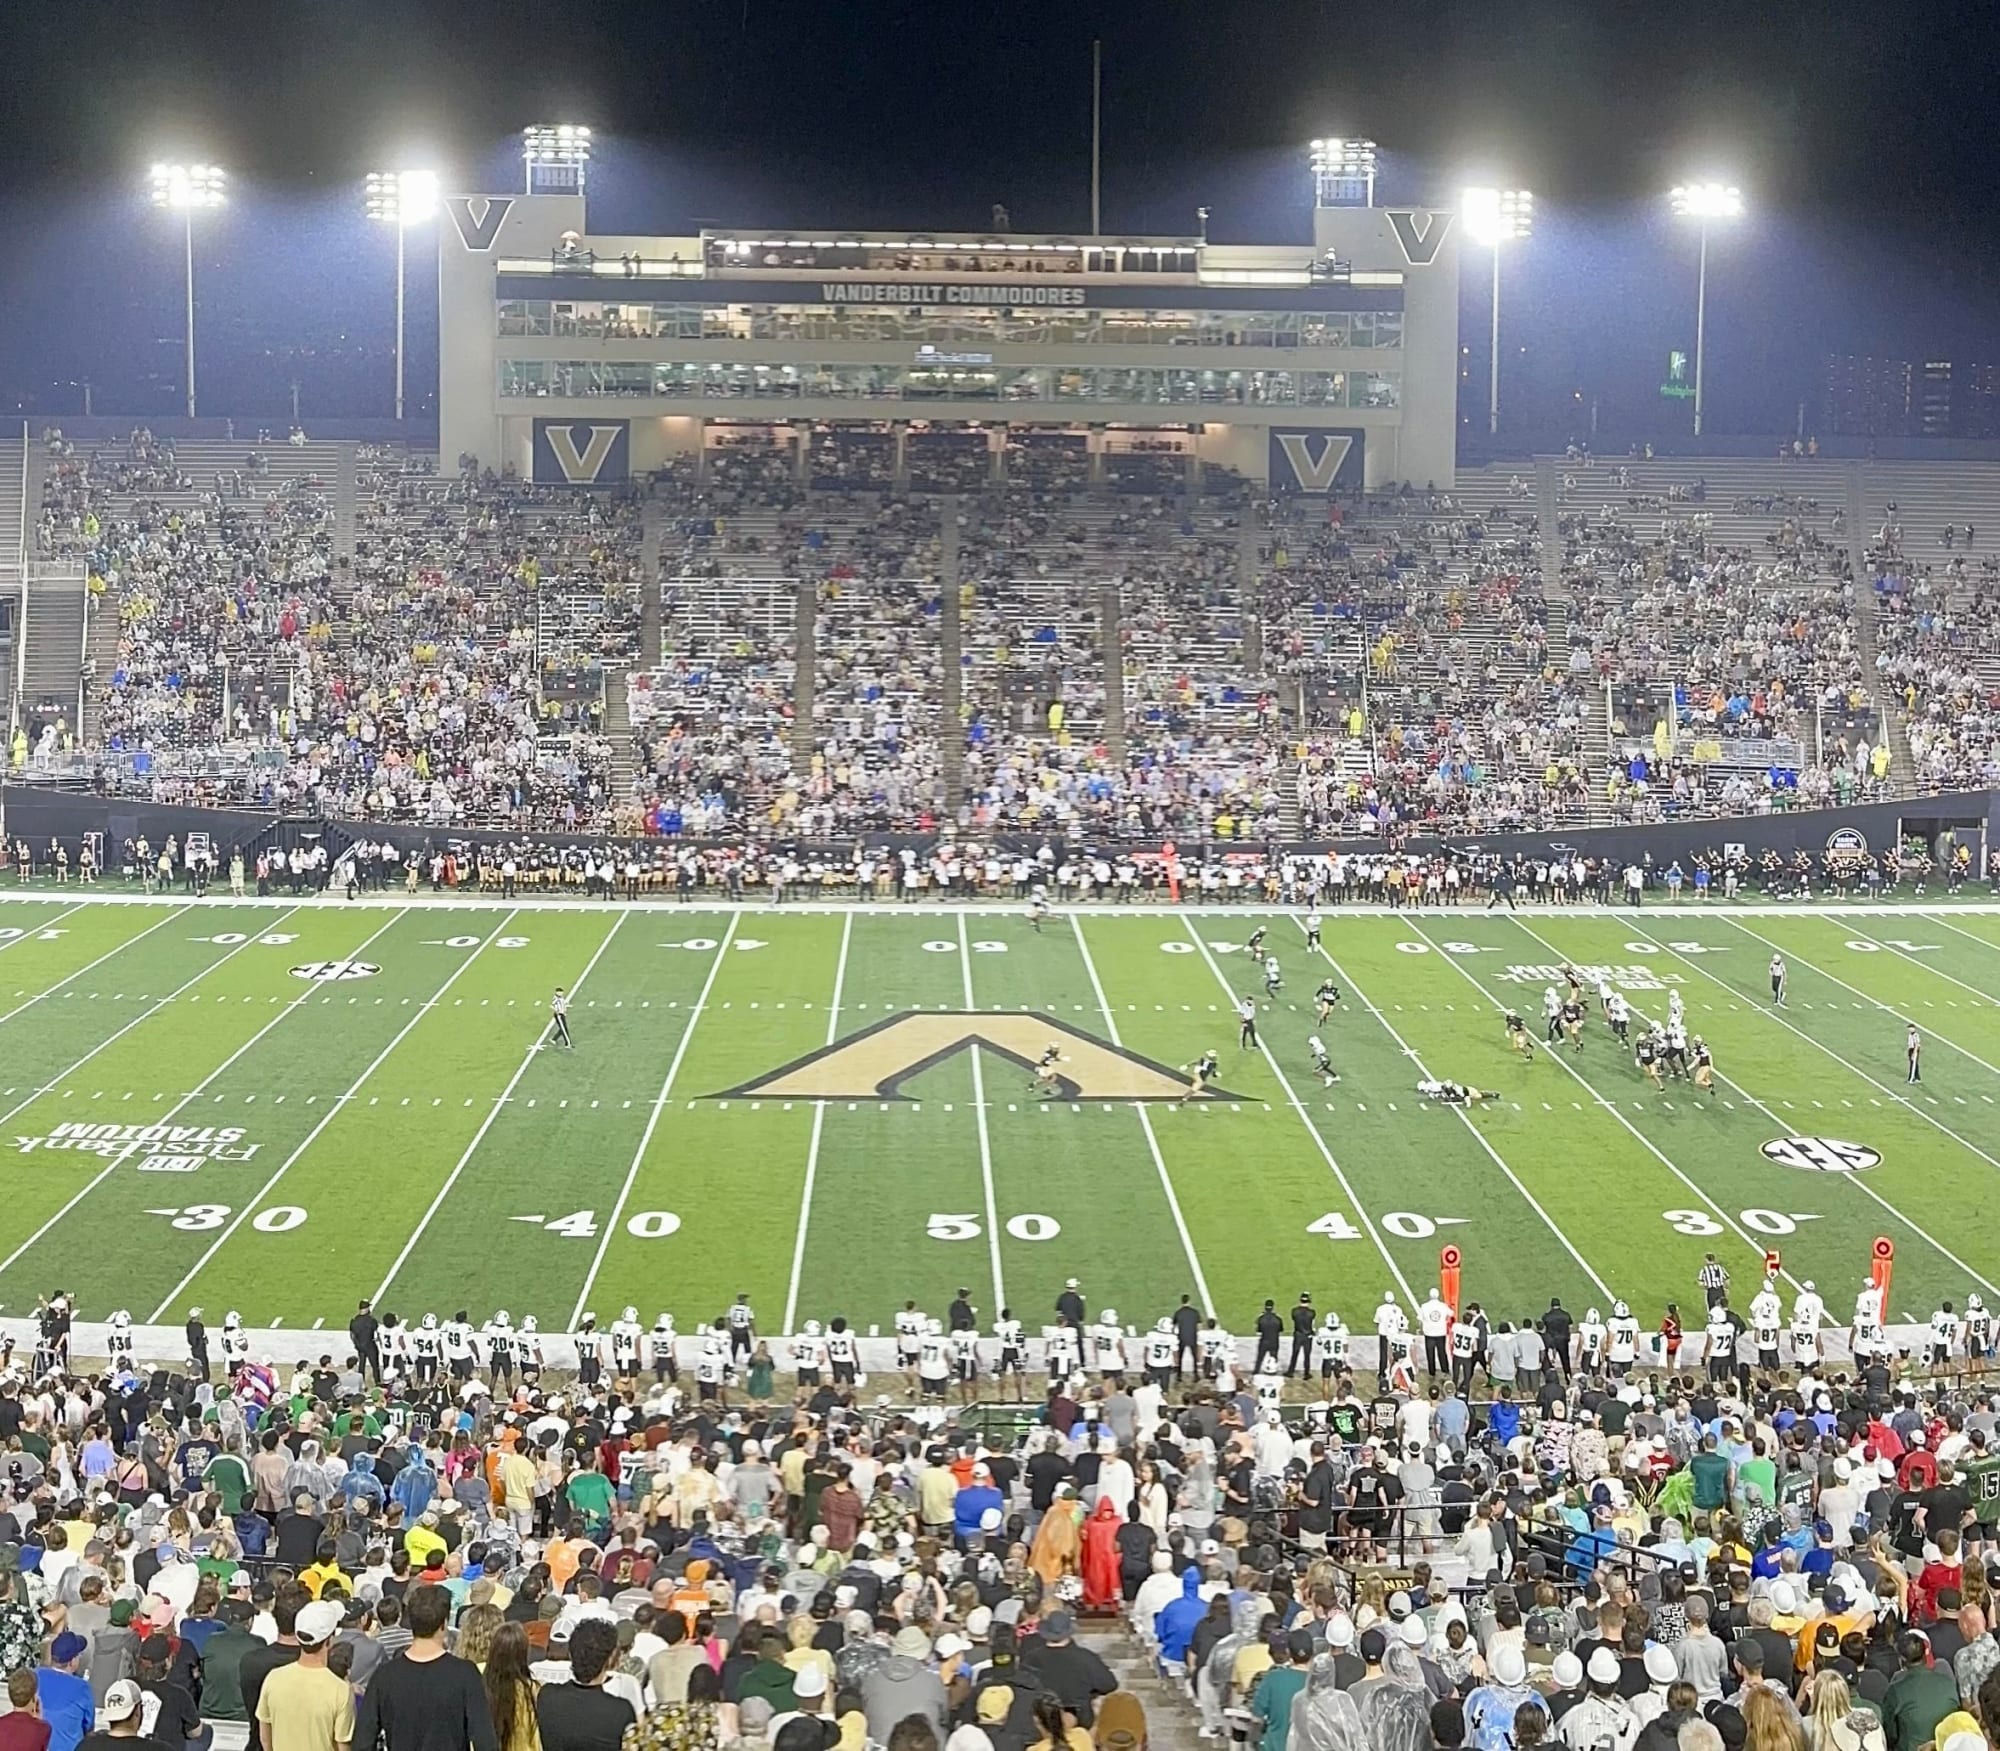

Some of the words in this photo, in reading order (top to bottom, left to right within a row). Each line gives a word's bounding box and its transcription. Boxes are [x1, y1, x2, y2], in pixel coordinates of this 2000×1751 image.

[445, 197, 515, 252] V
[1385, 211, 1454, 266] V
[822, 283, 943, 303] VANDERBILT
[946, 285, 1086, 305] COMMODORES
[544, 425, 623, 485] V
[1275, 433, 1353, 493] V
[48, 1122, 247, 1143] STADIUM
[5, 1136, 265, 1161] FirstBank
[1454, 1332, 1472, 1351] 33
[1617, 1329, 1633, 1345] 70
